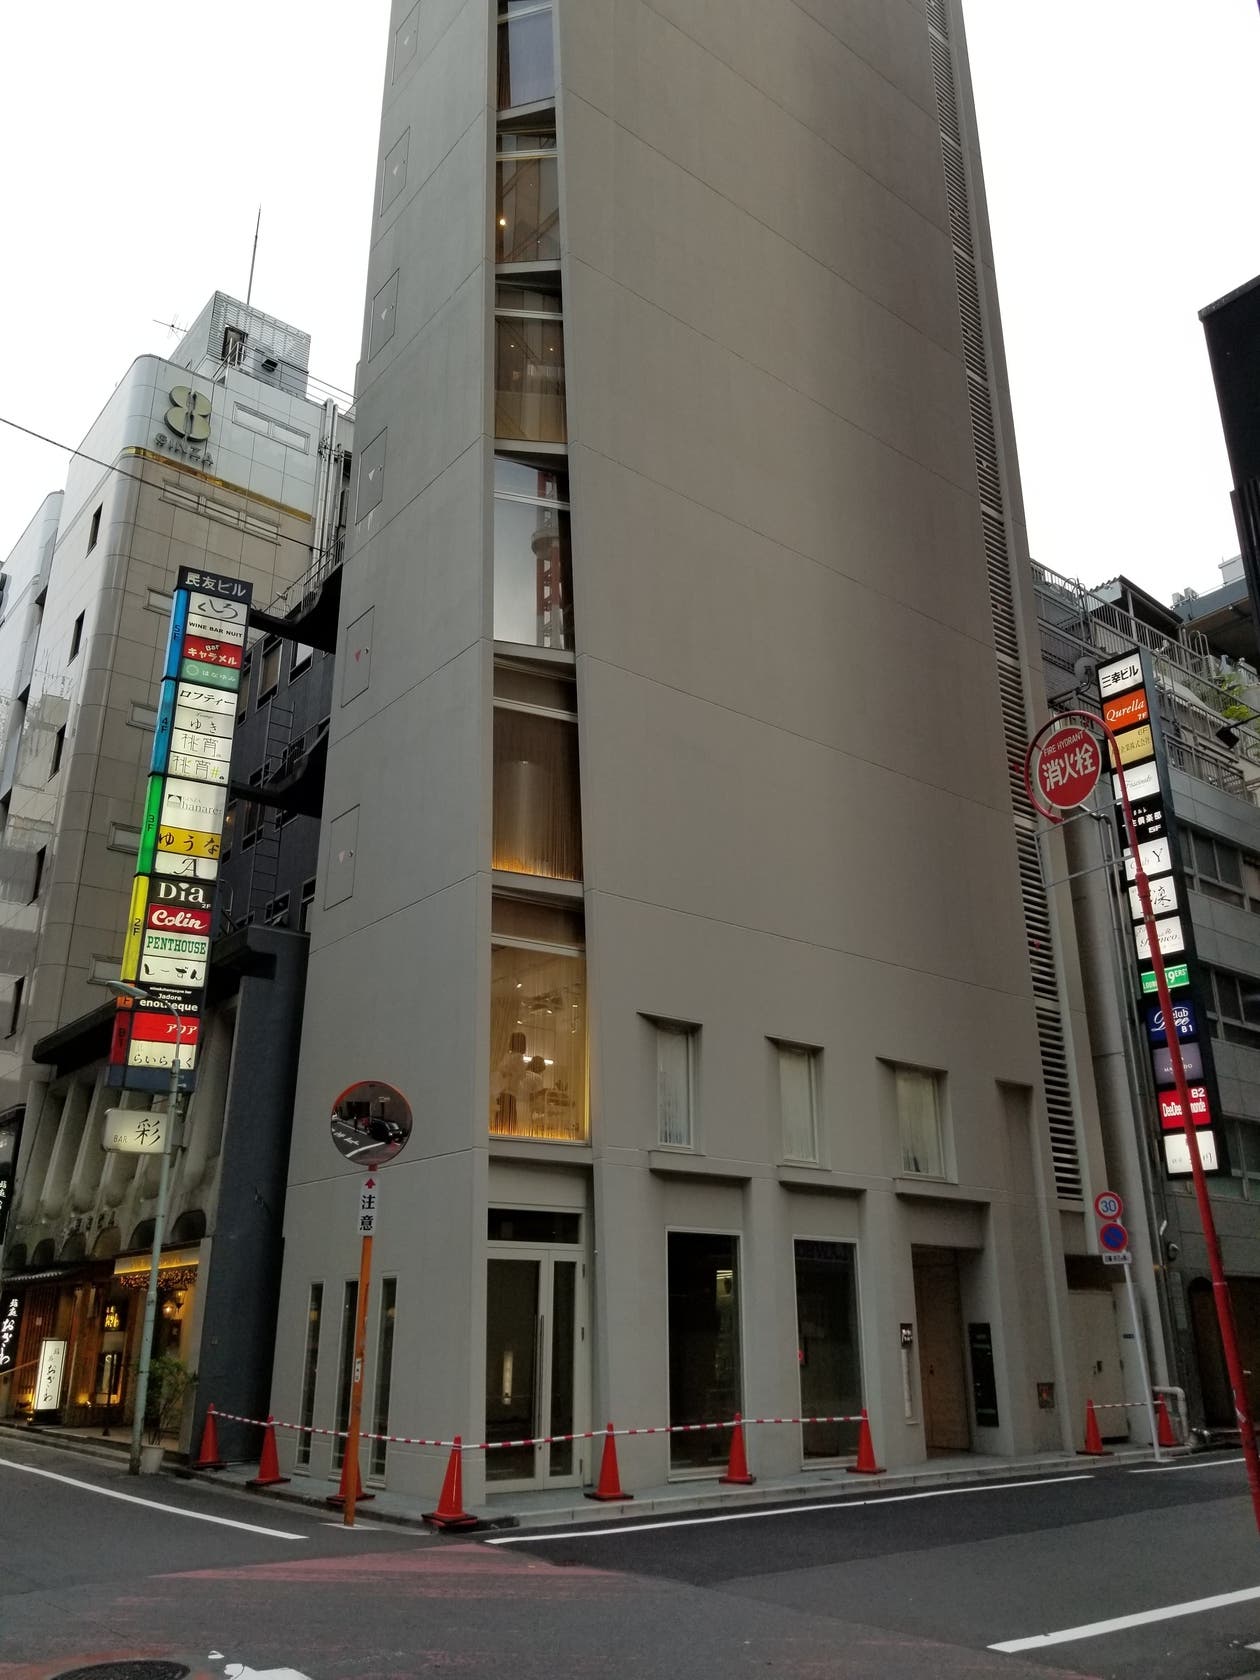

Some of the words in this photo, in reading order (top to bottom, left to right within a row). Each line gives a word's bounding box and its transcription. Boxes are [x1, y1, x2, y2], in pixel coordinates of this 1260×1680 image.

[185, 572, 246, 597] 民友ビル
[189, 621, 207, 630] WINE
[209, 626, 224, 634] BAR
[226, 630, 243, 638] NUIT
[187, 648, 237, 666] キャラメル
[1101, 665, 1139, 689] 三幸ビル
[180, 690, 235, 706] ロフティー
[1106, 699, 1145, 722] Qurella
[190, 718, 217, 734] ゆき
[1043, 744, 1056, 757] FIRE
[1057, 731, 1084, 750] HYDRANT
[1042, 743, 1096, 792] 消火栓
[159, 832, 219, 855] ゆうな
[157, 882, 205, 904] Dia
[133, 918, 141, 936] 2F
[152, 909, 208, 930] Colin
[146, 935, 207, 955] PENTHOUSE
[158, 993, 182, 1001] Jadore
[1191, 1088, 1206, 1098] B2
[113, 1134, 128, 1144] BAR
[135, 1118, 161, 1147] 彩
[359, 1194, 377, 1231] 注意
[1100, 1199, 1117, 1213] 30
